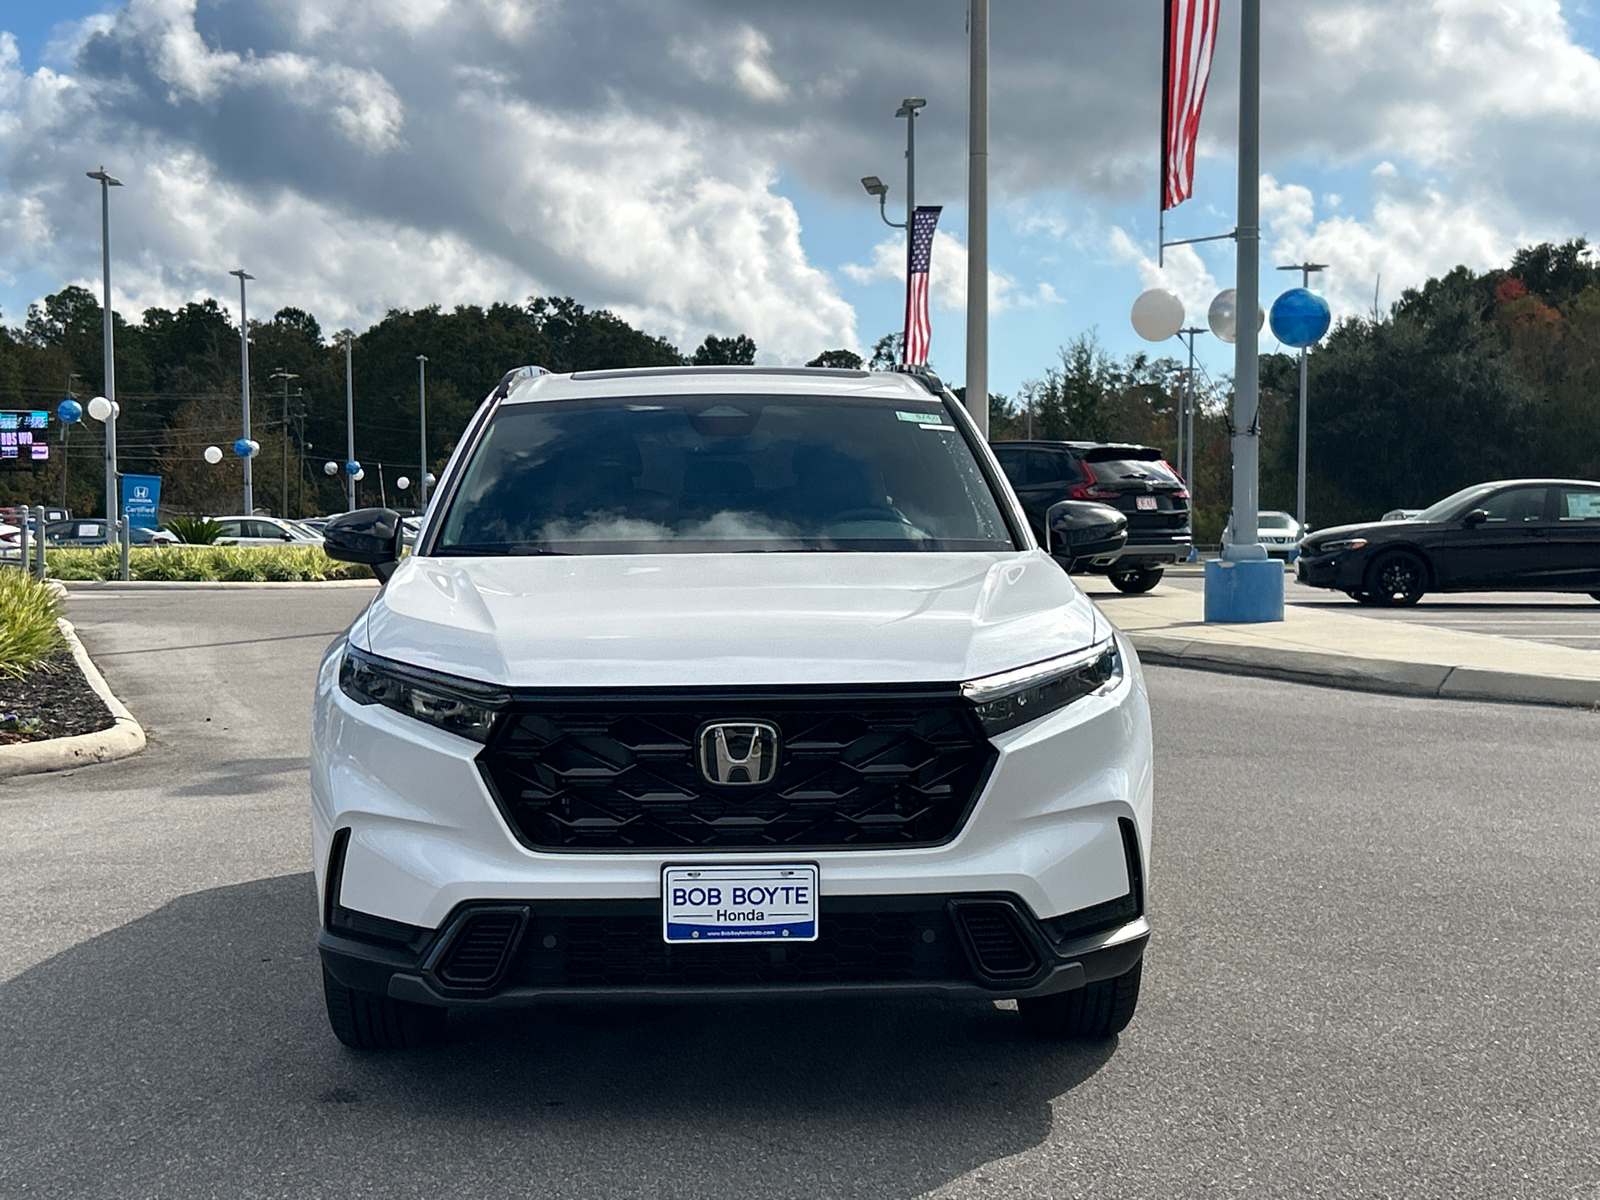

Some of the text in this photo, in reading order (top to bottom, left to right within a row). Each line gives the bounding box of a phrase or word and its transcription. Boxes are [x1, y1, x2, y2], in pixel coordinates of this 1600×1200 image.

[673, 886, 809, 906] BOB BOYTE
[716, 909, 764, 922] Honda
